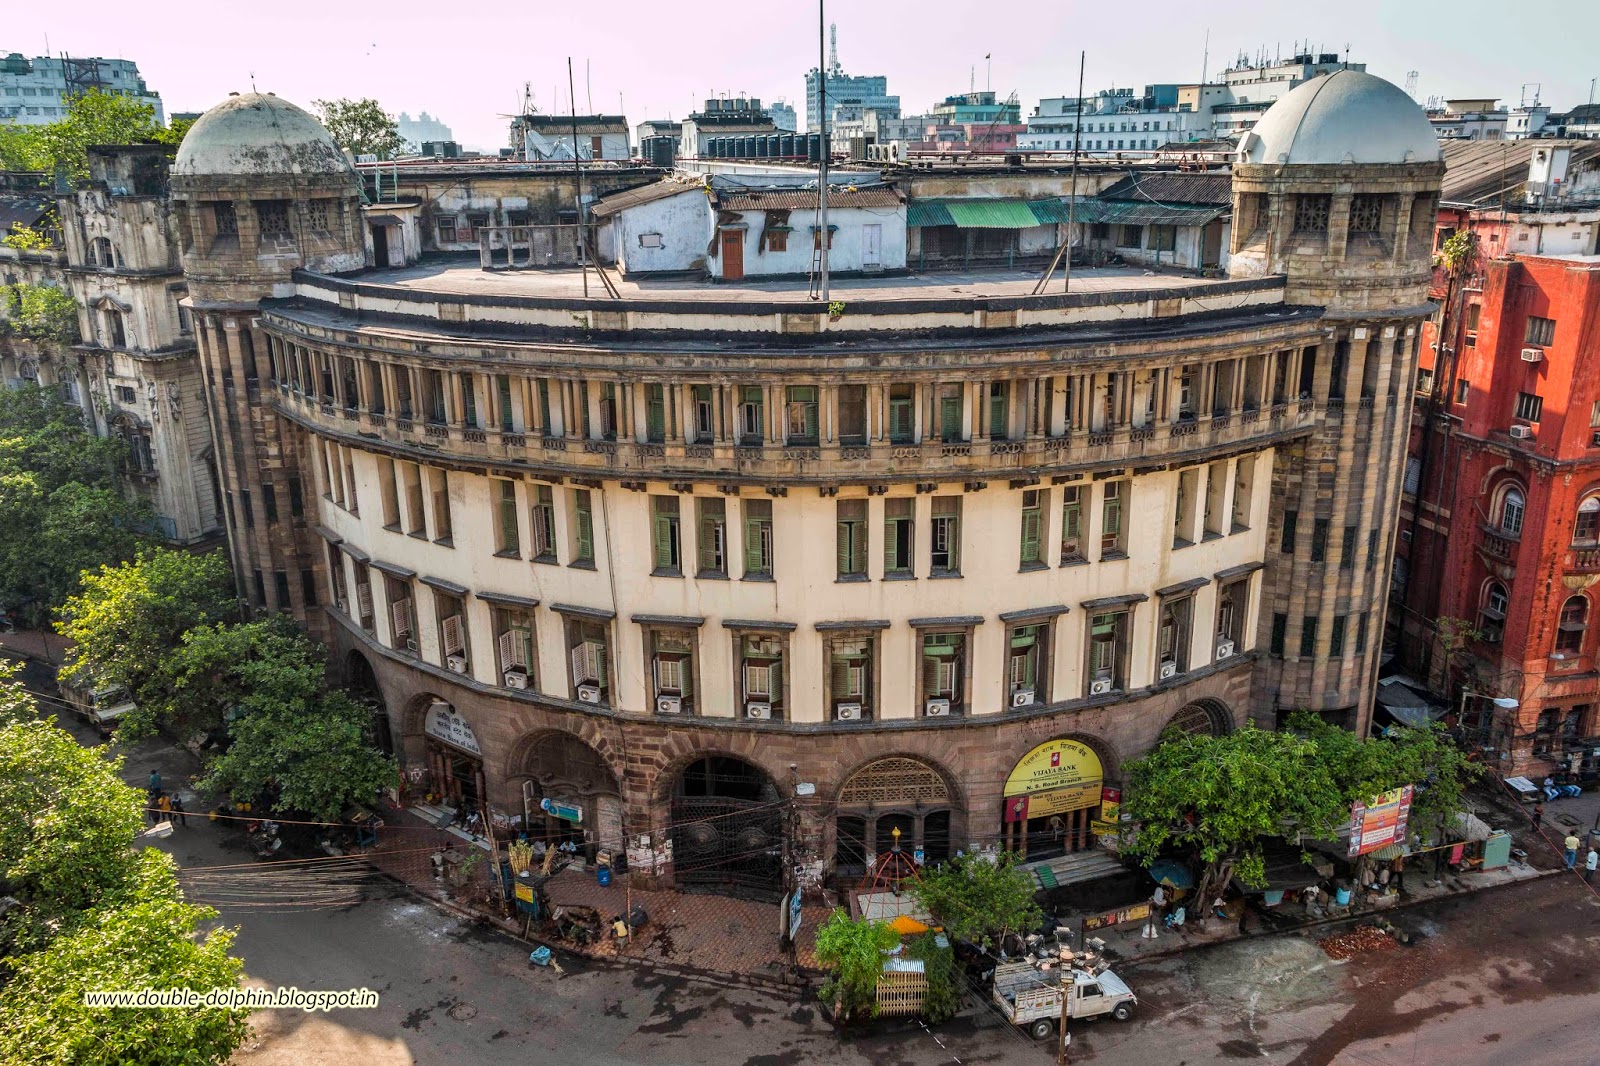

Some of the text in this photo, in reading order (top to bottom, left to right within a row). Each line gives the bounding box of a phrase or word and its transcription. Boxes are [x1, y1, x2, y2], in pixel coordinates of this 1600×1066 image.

[1033, 768, 1057, 777] VIJAYA
[1057, 764, 1077, 773] BANK
[1060, 777, 1082, 785] Branch
